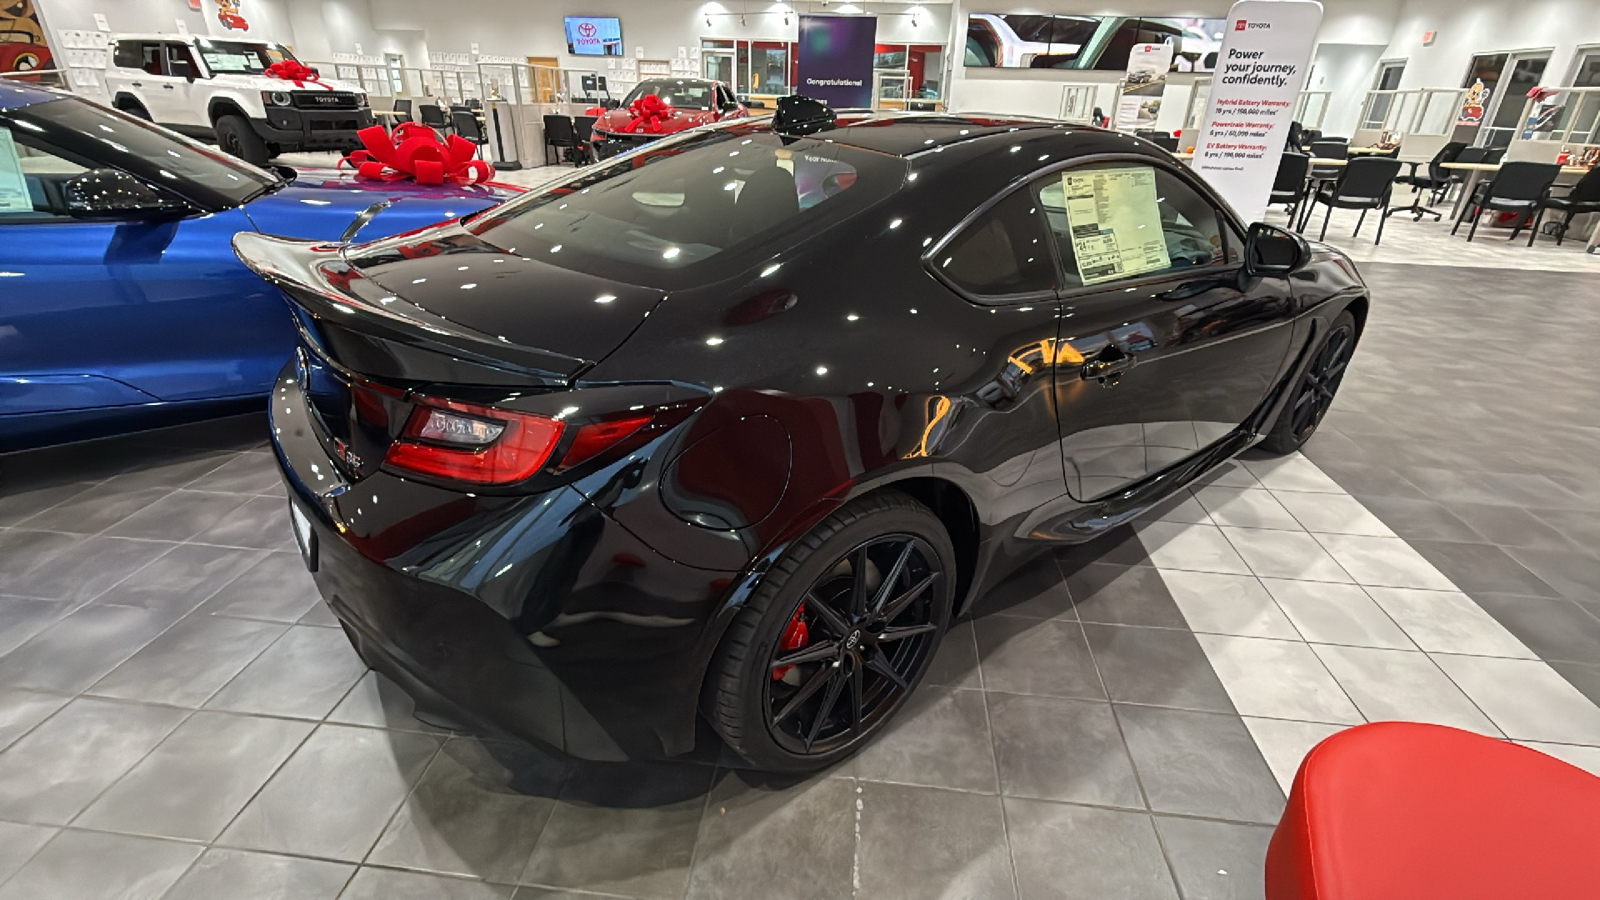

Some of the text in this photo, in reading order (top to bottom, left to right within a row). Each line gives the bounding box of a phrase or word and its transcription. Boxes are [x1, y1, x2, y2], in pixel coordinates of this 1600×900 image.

[1228, 48, 1264, 59] Power
[1224, 62, 1296, 76] your journey,
[806, 78, 863, 86] Congratulations!
[1222, 74, 1288, 87] confidently.
[1216, 98, 1238, 106] Hybrid
[1238, 99, 1260, 107] Battery
